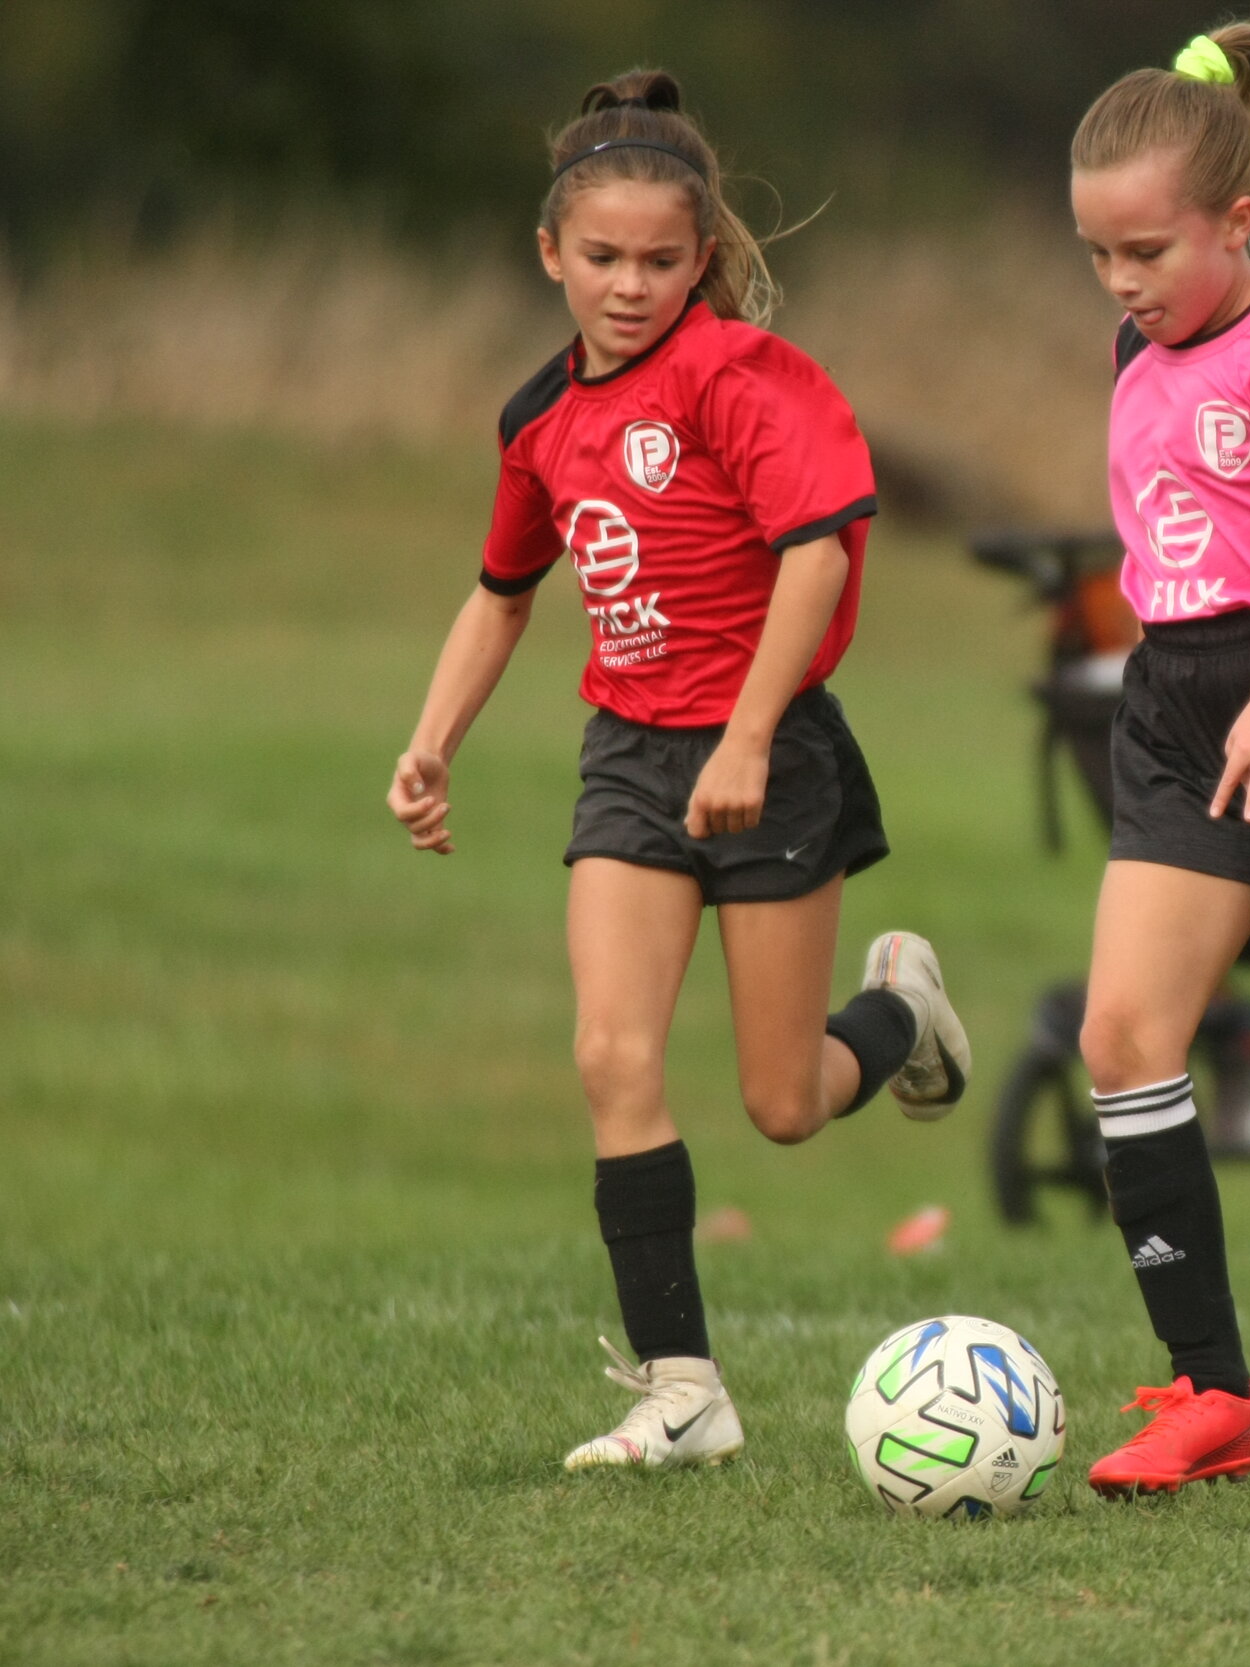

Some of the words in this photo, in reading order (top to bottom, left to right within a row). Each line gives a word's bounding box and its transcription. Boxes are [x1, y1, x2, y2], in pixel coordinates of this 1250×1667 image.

[1220, 457, 1242, 467] 2009
[647, 472, 669, 483] 2009
[646, 642, 667, 659] LLC
[1131, 1249, 1187, 1268] adidas
[992, 1459, 1019, 1468] adidas
